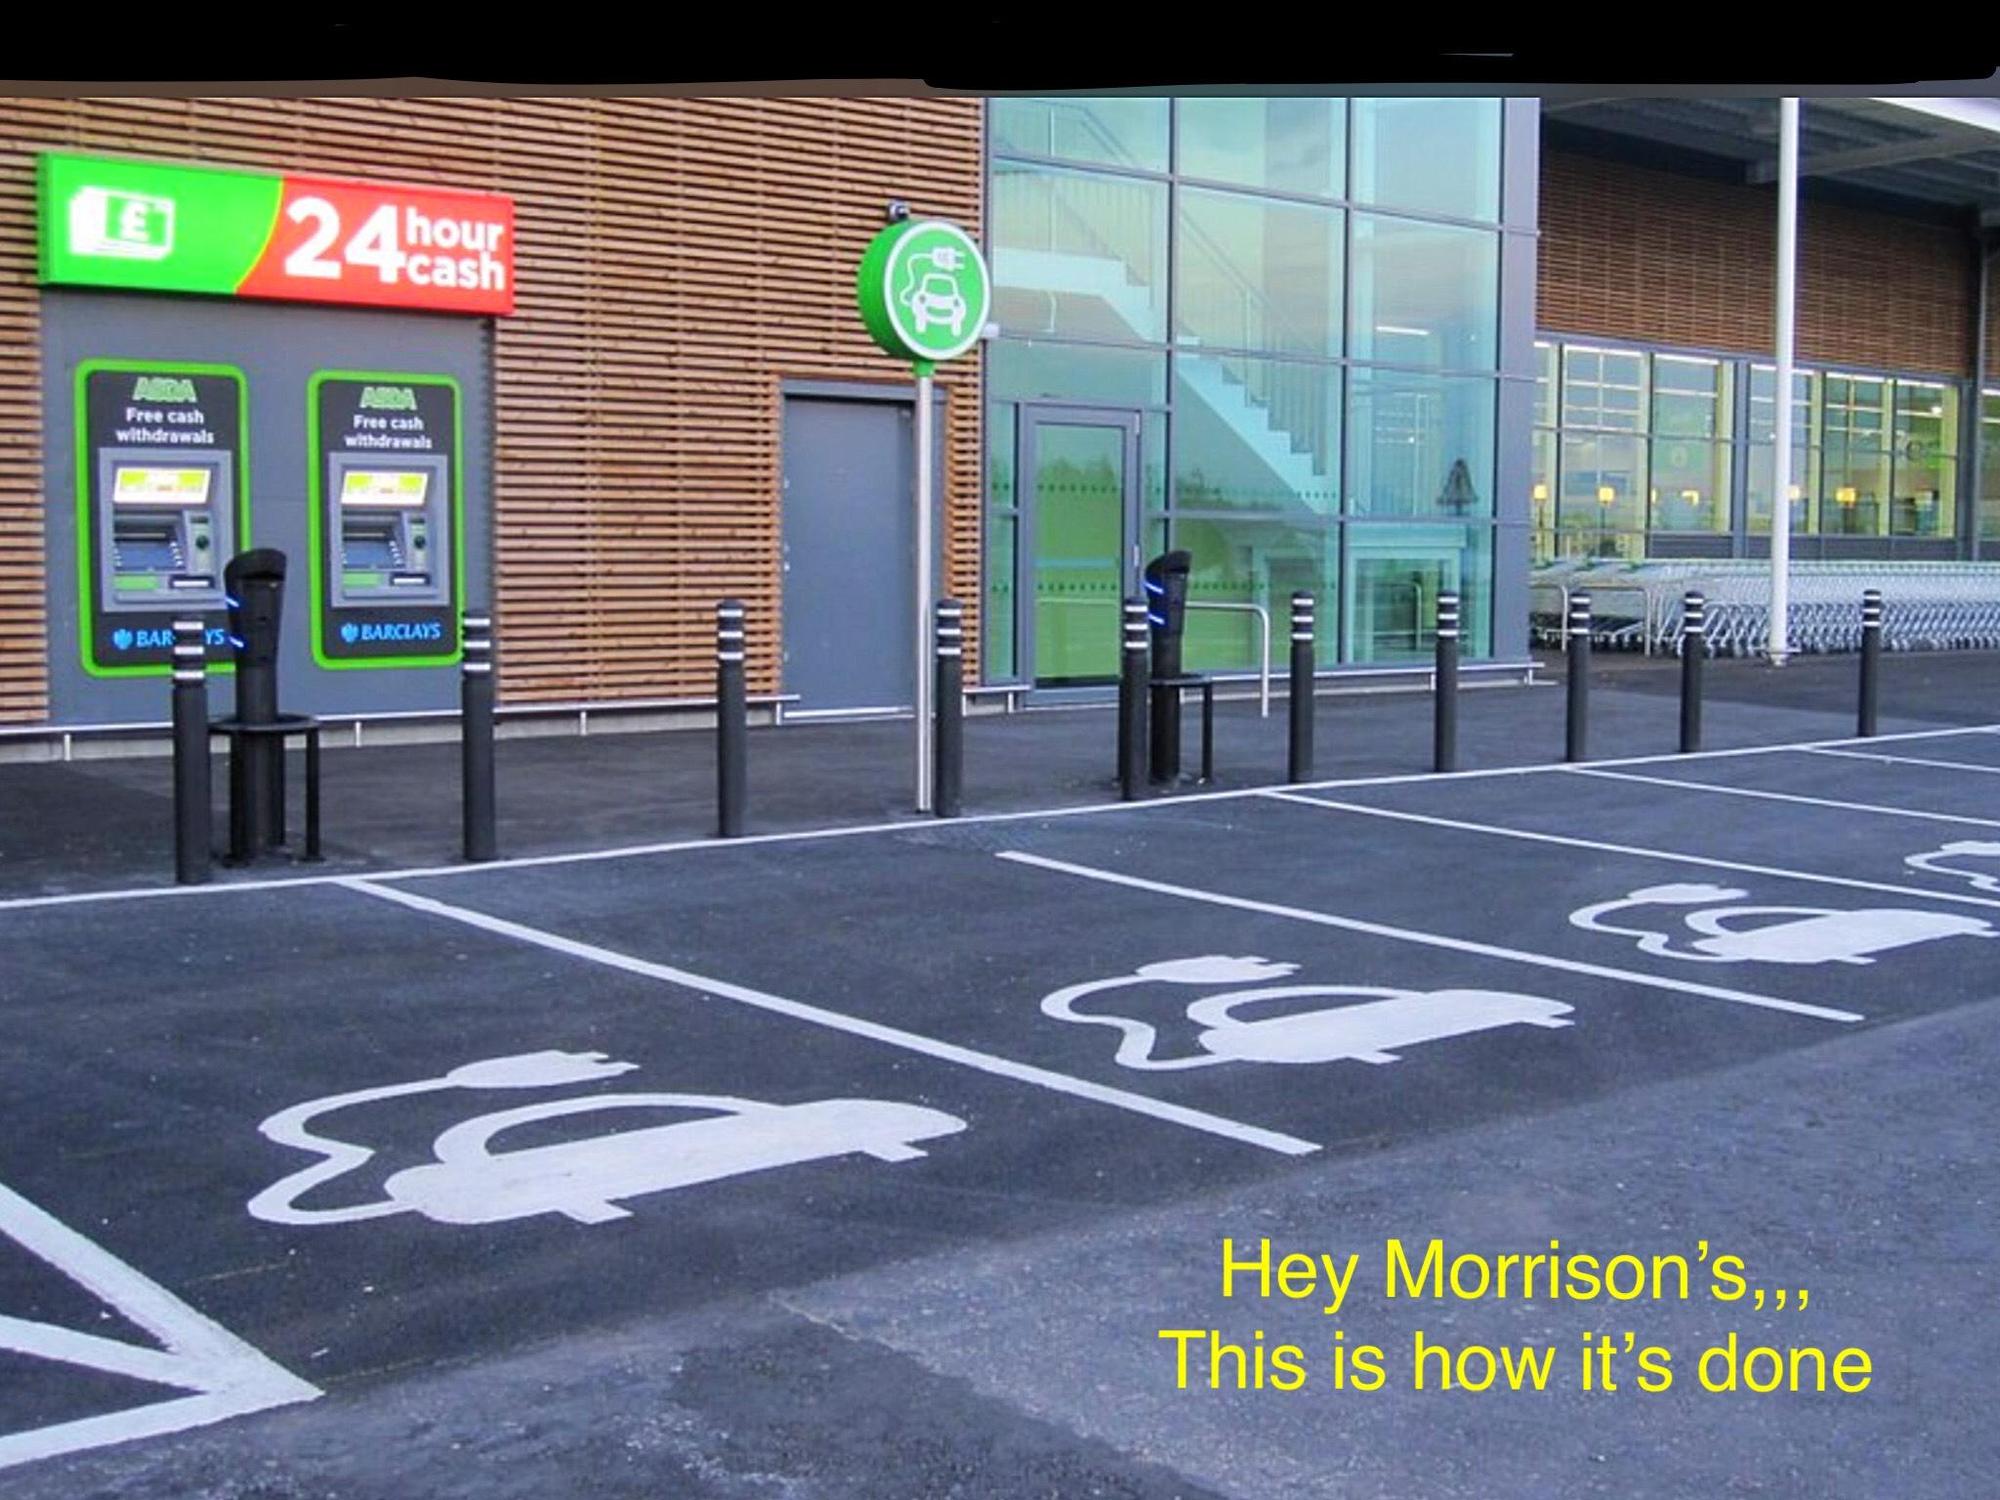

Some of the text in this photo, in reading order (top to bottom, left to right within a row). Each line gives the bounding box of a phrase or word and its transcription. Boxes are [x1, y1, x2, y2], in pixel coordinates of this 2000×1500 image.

[406, 207, 505, 250] hour
[285, 197, 402, 283] 24
[405, 252, 506, 291] cash
[126, 407, 204, 424] Free cash
[353, 414, 424, 431] Free cash
[116, 427, 215, 444] withdrawals
[344, 433, 433, 449] withdrawals
[136, 629, 225, 647] BARYS
[361, 623, 442, 642] BARCLAYS
